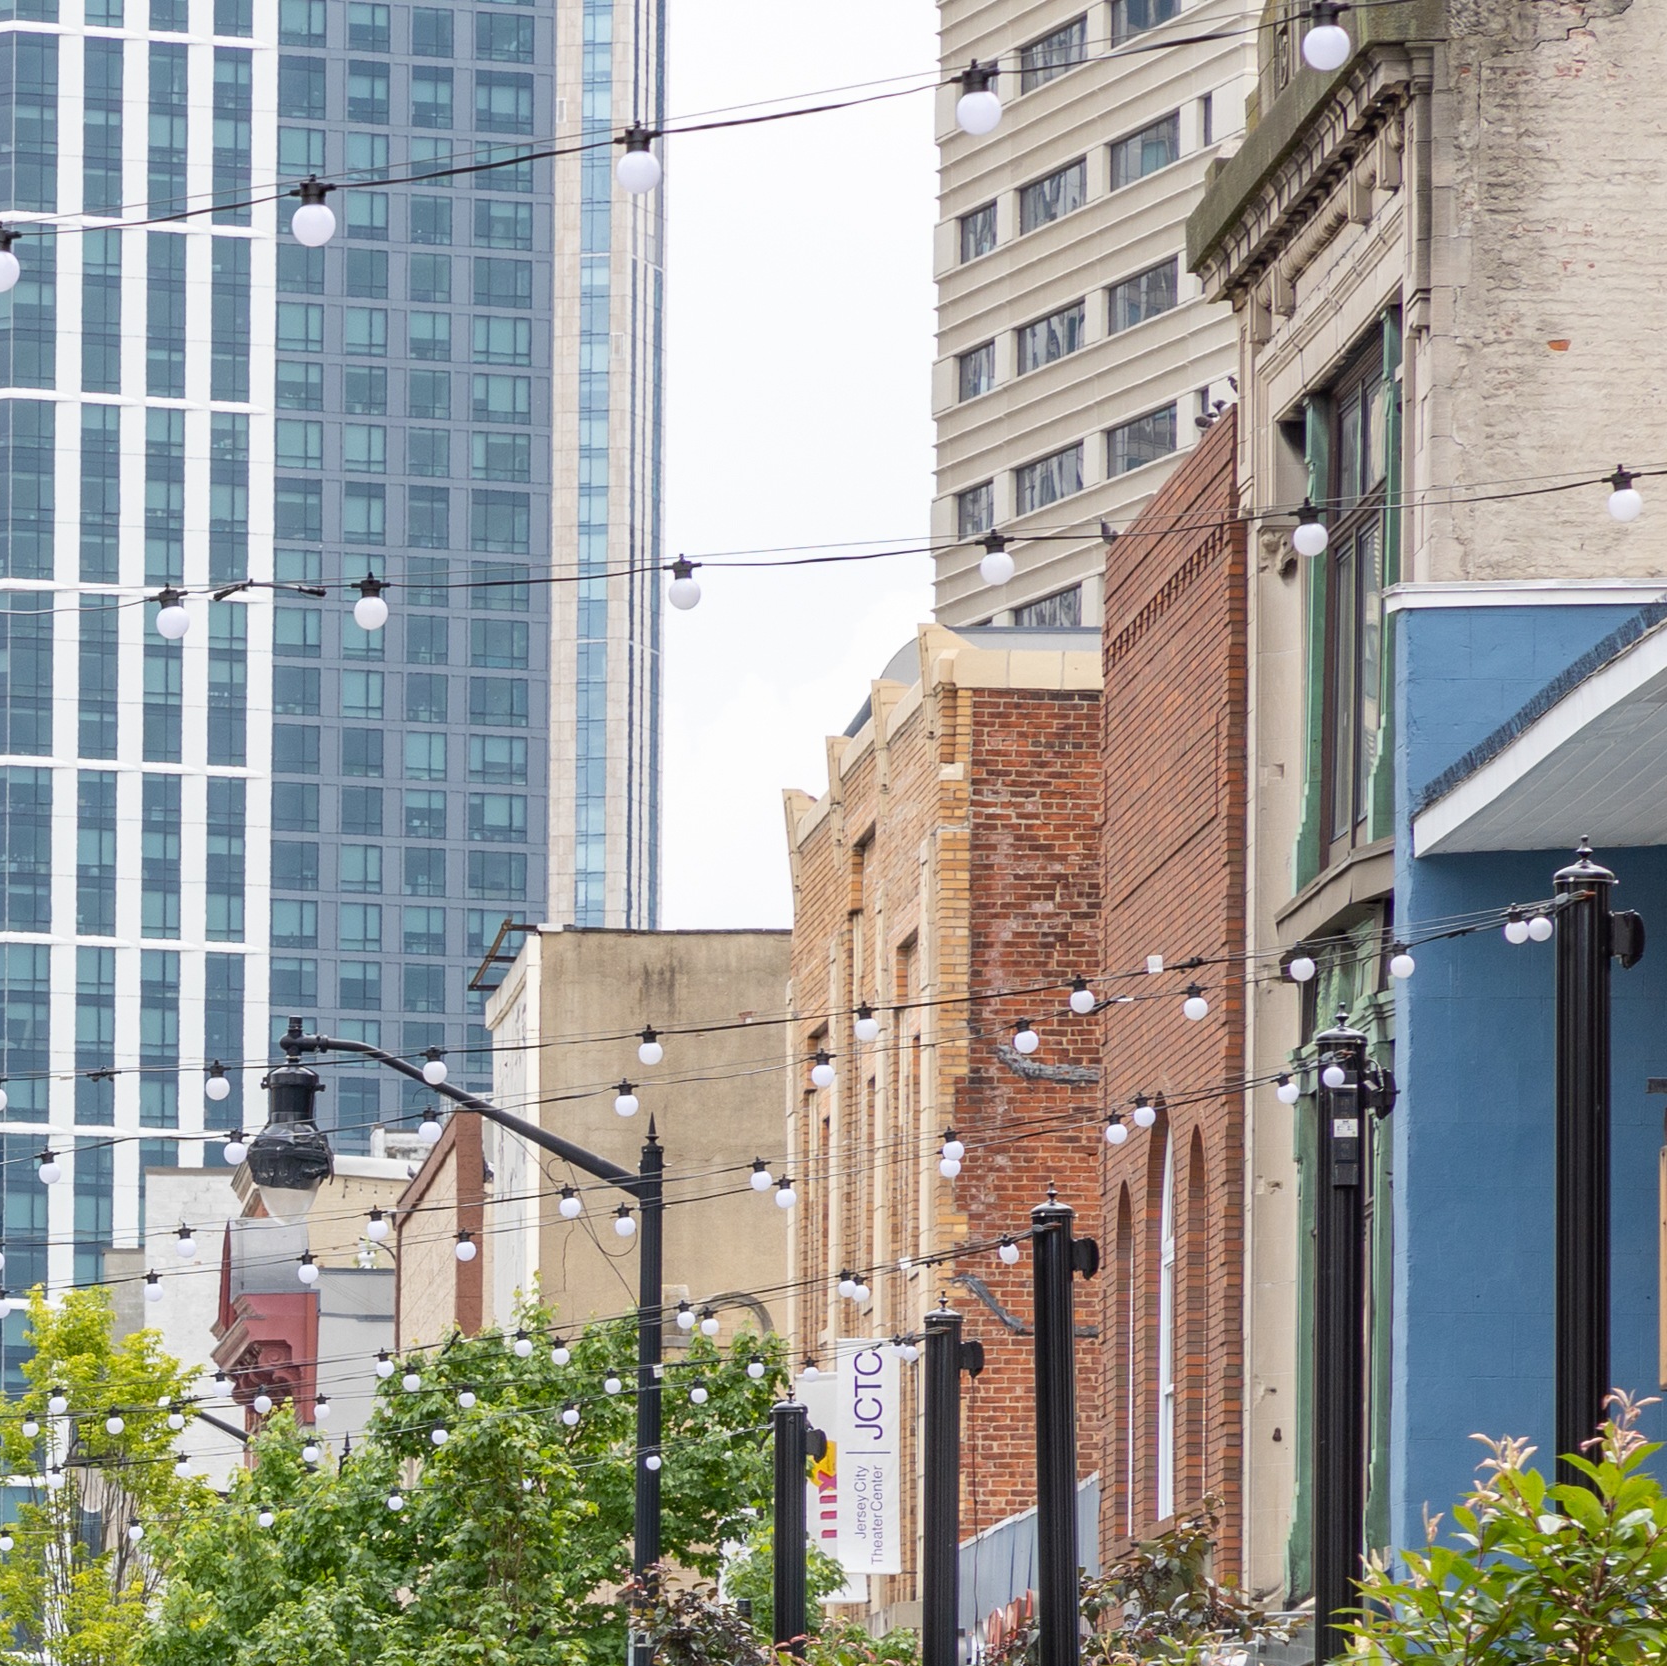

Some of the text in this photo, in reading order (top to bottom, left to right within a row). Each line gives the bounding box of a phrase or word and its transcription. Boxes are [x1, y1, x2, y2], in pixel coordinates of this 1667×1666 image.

[853, 1351, 884, 1440] JCTC
[854, 1465, 870, 1539] Jersey City
[871, 1465, 884, 1565] Theater Center
